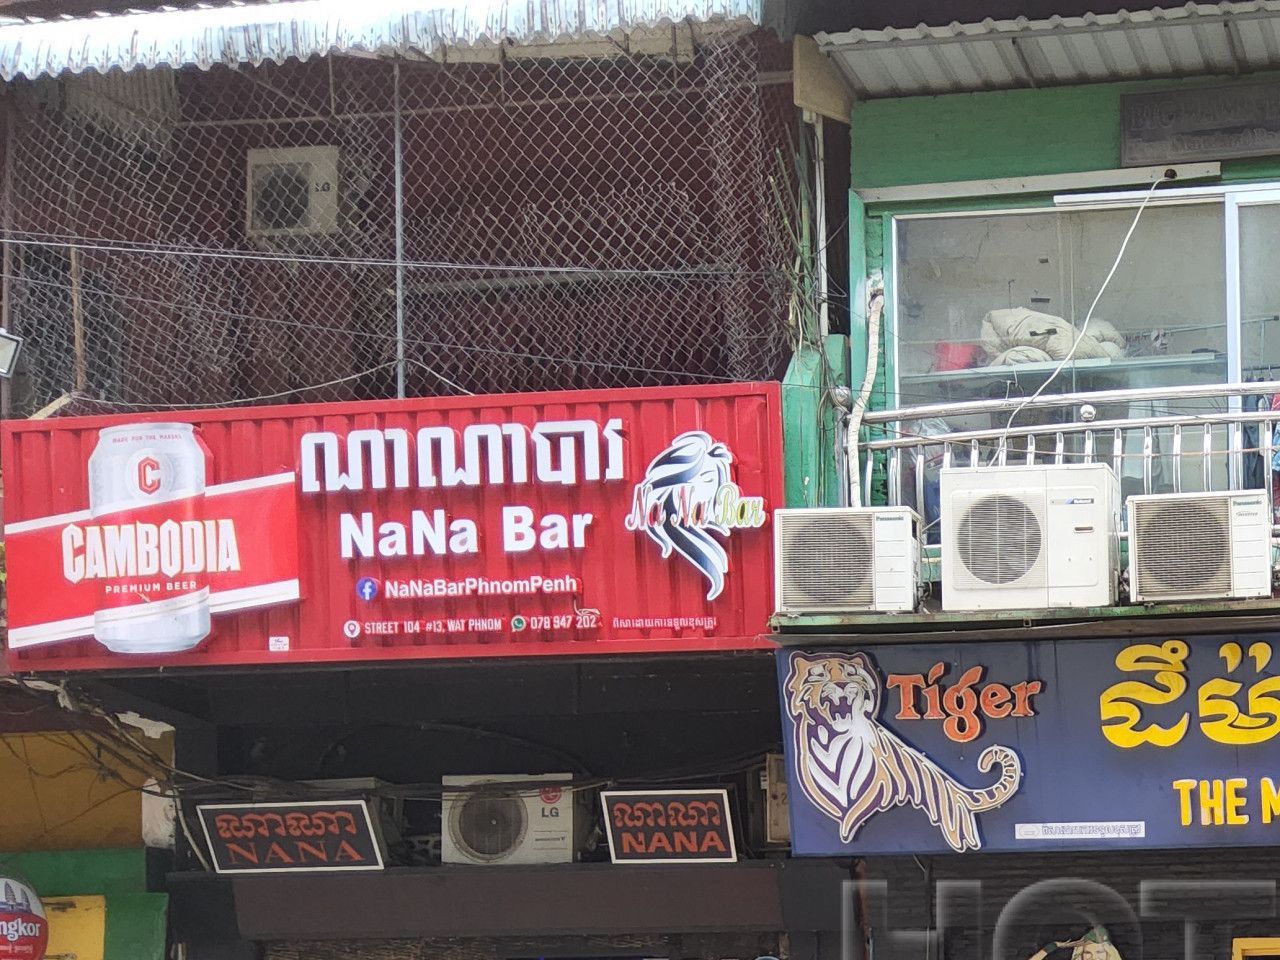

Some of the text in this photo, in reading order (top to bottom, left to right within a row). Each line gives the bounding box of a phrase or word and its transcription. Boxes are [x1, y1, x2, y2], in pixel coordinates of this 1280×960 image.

[301, 418, 623, 492] ណាណាបារ
[340, 505, 593, 558] NaNa Bar
[61, 518, 241, 584] CAMBODIA
[105, 580, 197, 594] PREMIUM BEER
[385, 574, 577, 598] NaNaBarPhnomPenh
[364, 621, 398, 634] STREET
[404, 620, 420, 633] 104
[447, 618, 465, 631] WAT
[468, 617, 501, 631] PHNOM
[553, 615, 572, 628] 947
[576, 614, 596, 628] 202
[886, 661, 1042, 743] Tiger
[541, 806, 559, 817] LG
[1173, 777, 1250, 826] THE
[225, 840, 367, 864] NANA
[621, 831, 727, 853] NANA
